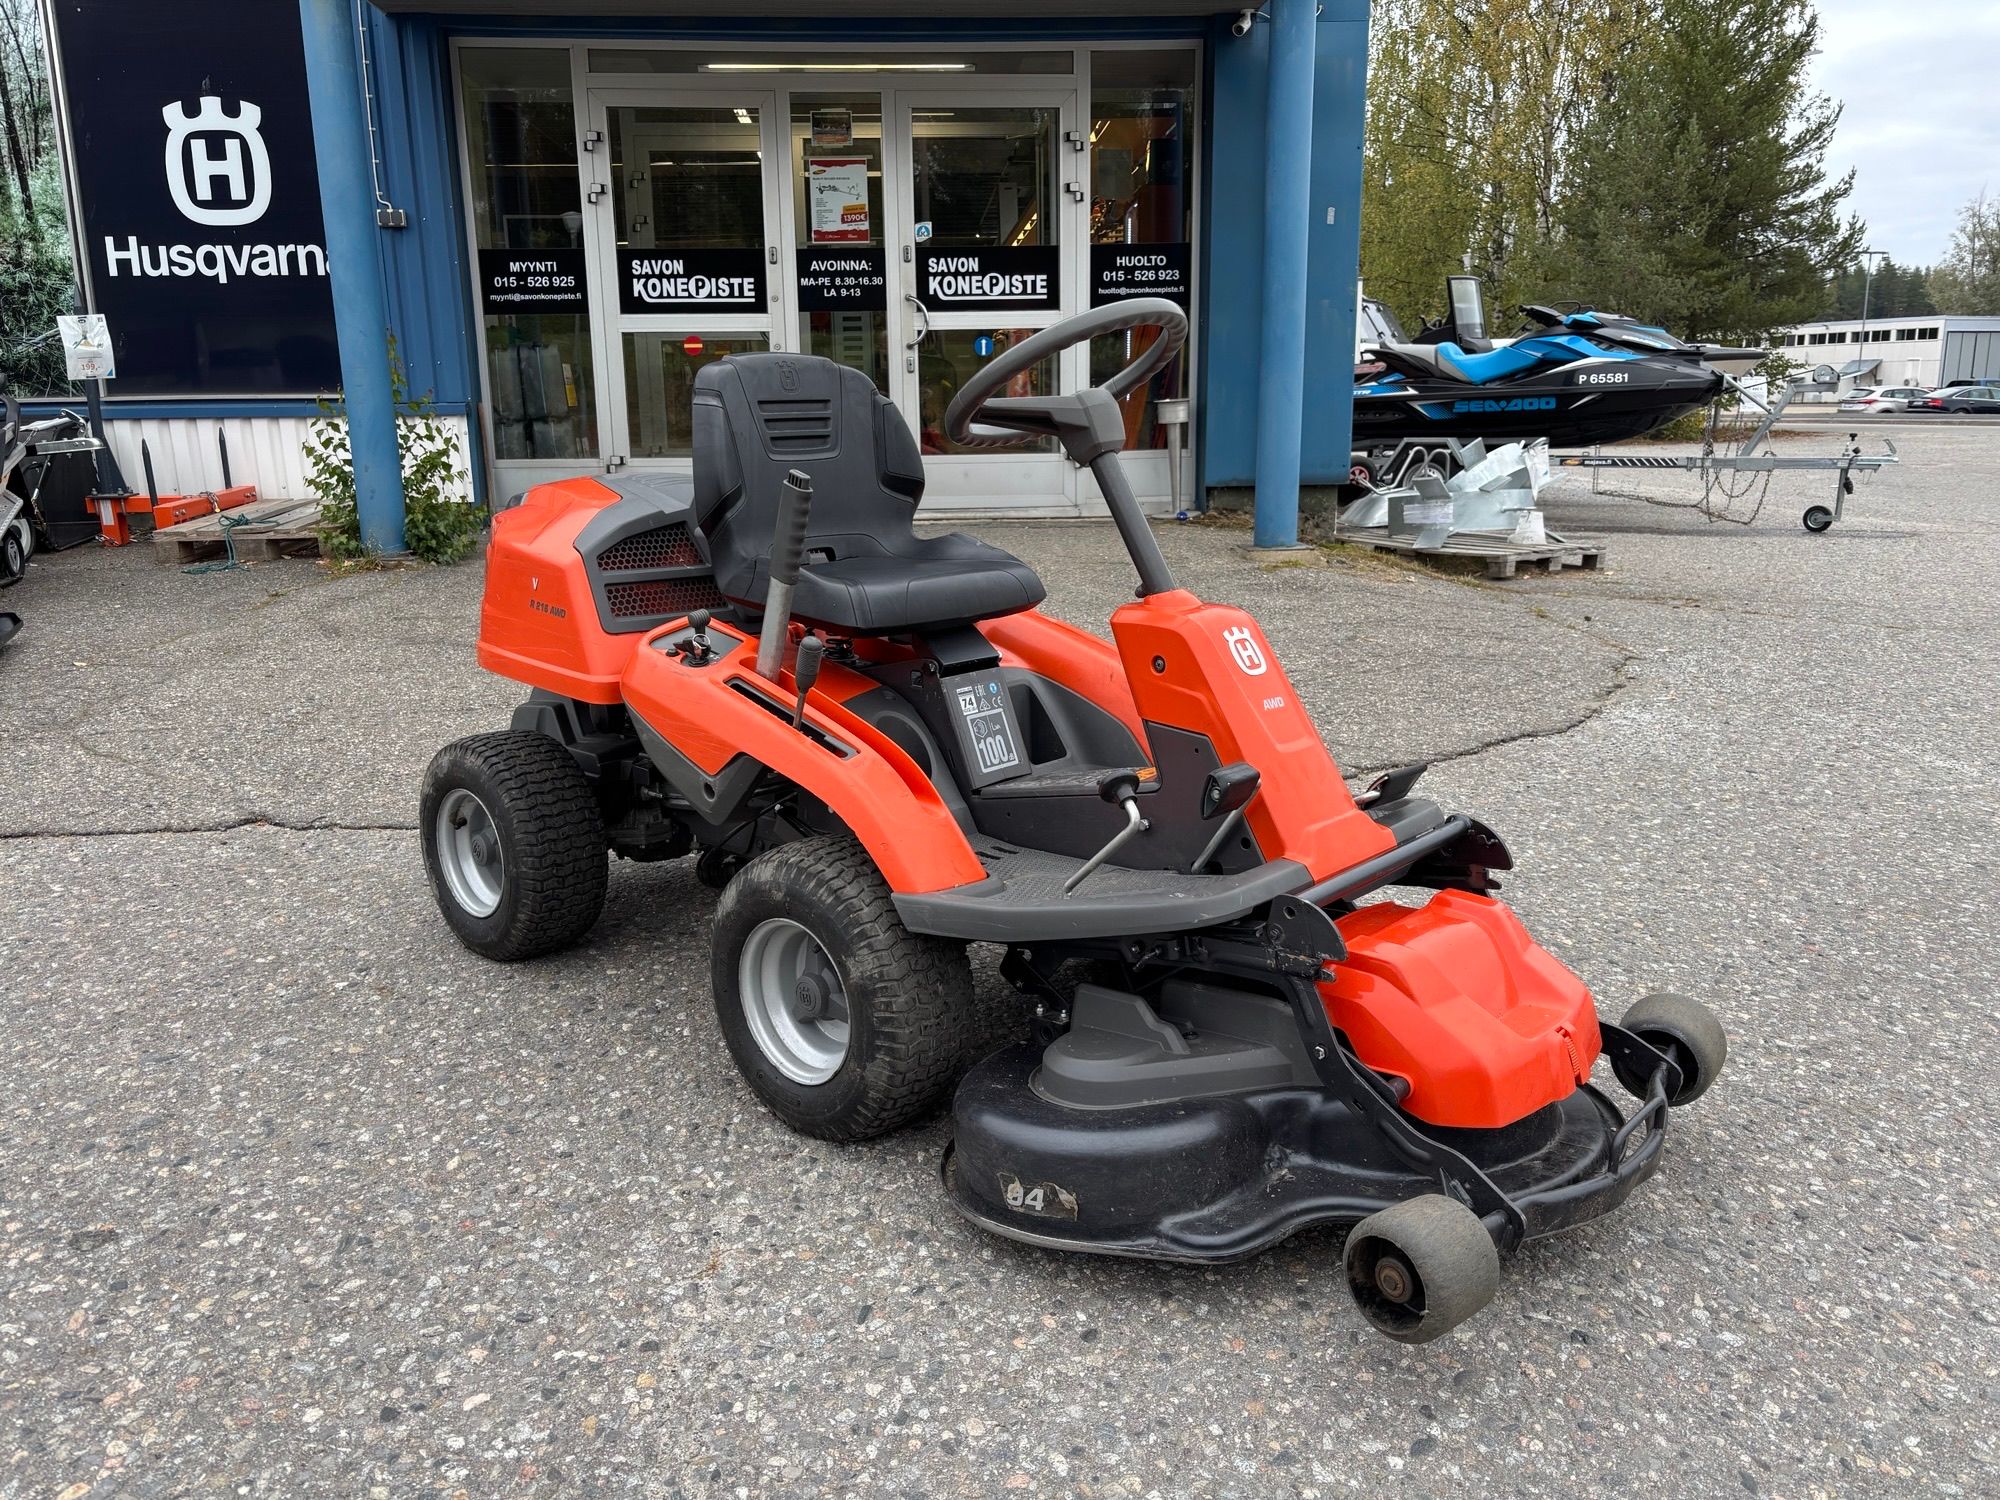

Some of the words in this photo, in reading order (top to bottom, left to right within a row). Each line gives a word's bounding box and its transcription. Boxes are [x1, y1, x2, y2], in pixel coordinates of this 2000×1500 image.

[843, 213, 866, 222] 1390€
[104, 235, 332, 284] Husqvarn
[810, 260, 872, 271] AVOINNA:
[928, 257, 979, 273] SAVON
[1116, 255, 1167, 267] HUOLTO
[509, 261, 557, 273] MYYNTI
[631, 259, 684, 275] SAVON
[494, 276, 517, 288] 015
[527, 276, 550, 287] 526
[552, 275, 575, 287] 925
[800, 277, 832, 286] MA-PE
[835, 276, 883, 286] 8.30-16.30
[1103, 271, 1125, 282] 015
[1134, 270, 1156, 281] 526
[1158, 269, 1180, 280] 923
[633, 274, 755, 302] KONEPISTE
[928, 272, 1047, 300] KONEPISTE
[1098, 285, 1185, 296] huolto@savonkonepiste.fi
[490, 292, 582, 302] myynti@savonkonepiste.fi
[823, 288, 837, 297] LA
[840, 288, 861, 297] 9-13
[1578, 374, 1587, 384] P
[1589, 373, 1629, 384] 65581
[550, 606, 567, 618] AWD
[962, 697, 974, 708] 74
[1263, 696, 1285, 710] AWD
[979, 734, 1009, 766] 100
